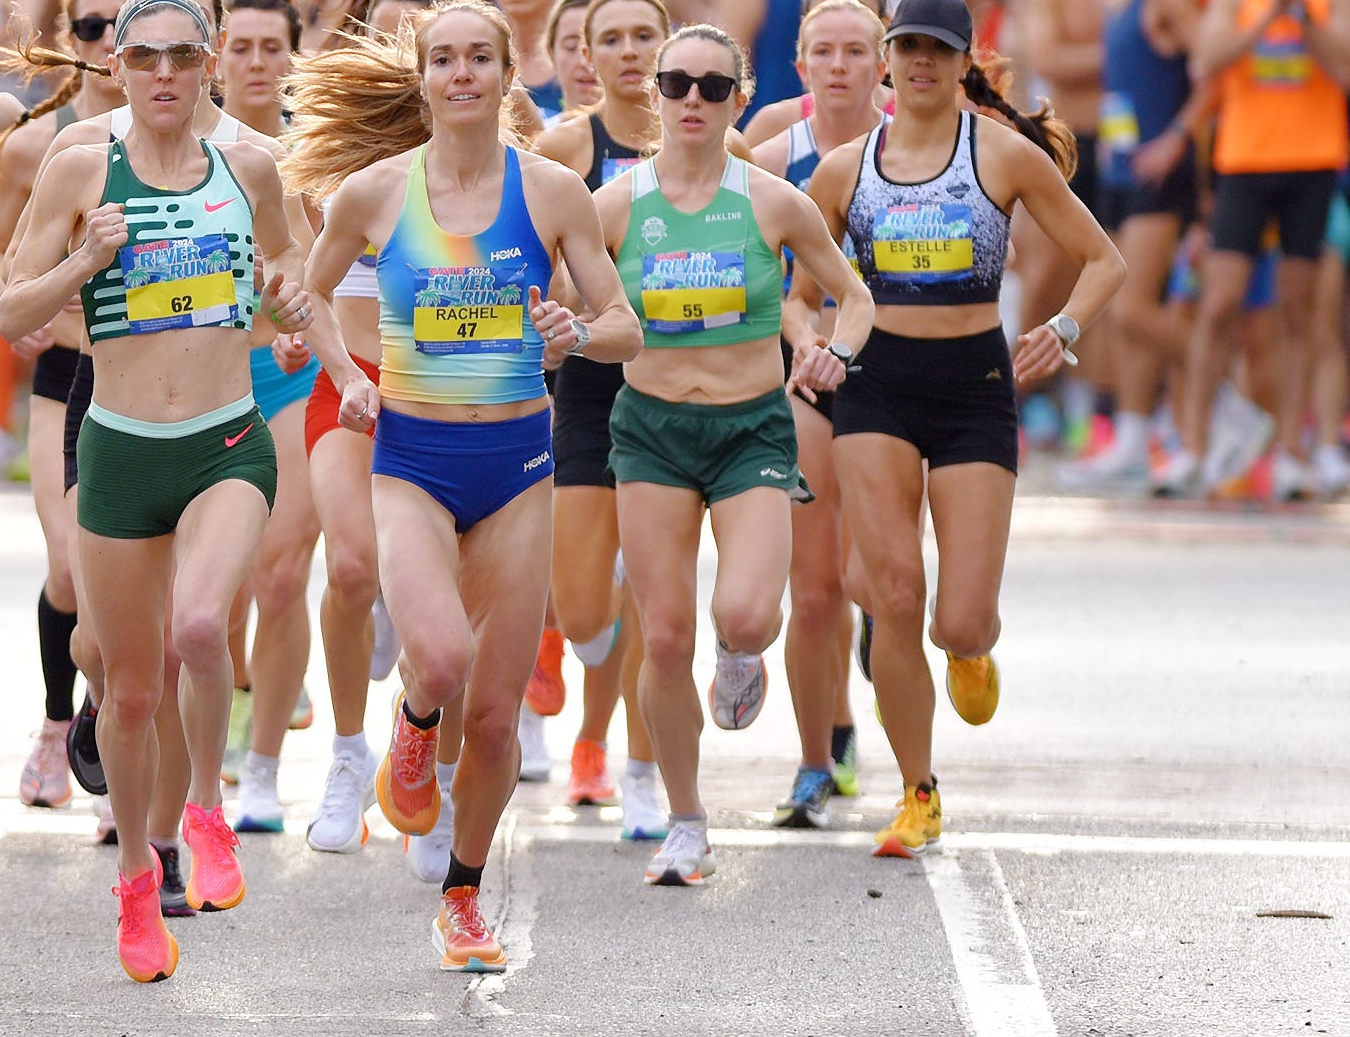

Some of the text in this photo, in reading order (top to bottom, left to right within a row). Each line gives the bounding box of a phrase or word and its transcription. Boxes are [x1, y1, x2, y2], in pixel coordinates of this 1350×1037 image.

[705, 211, 742, 222] BAKLINE
[890, 210, 945, 225] RIVER
[913, 225, 949, 239] RUN
[133, 239, 194, 253] GATE 2024
[890, 241, 951, 252] ESTELLE
[140, 245, 201, 268] RIVER
[490, 247, 522, 262] HOKA
[912, 255, 930, 269] 35
[171, 261, 208, 278] RUN
[429, 267, 465, 275] GATE
[658, 258, 716, 274] RIVER
[433, 274, 496, 291] RIVER
[684, 273, 721, 288] RUN
[171, 295, 194, 312] 62
[461, 290, 499, 306] RUN
[436, 307, 498, 320] RACHEL
[683, 304, 703, 317] 55
[457, 323, 477, 338] 47
[523, 451, 550, 473] HOKA
